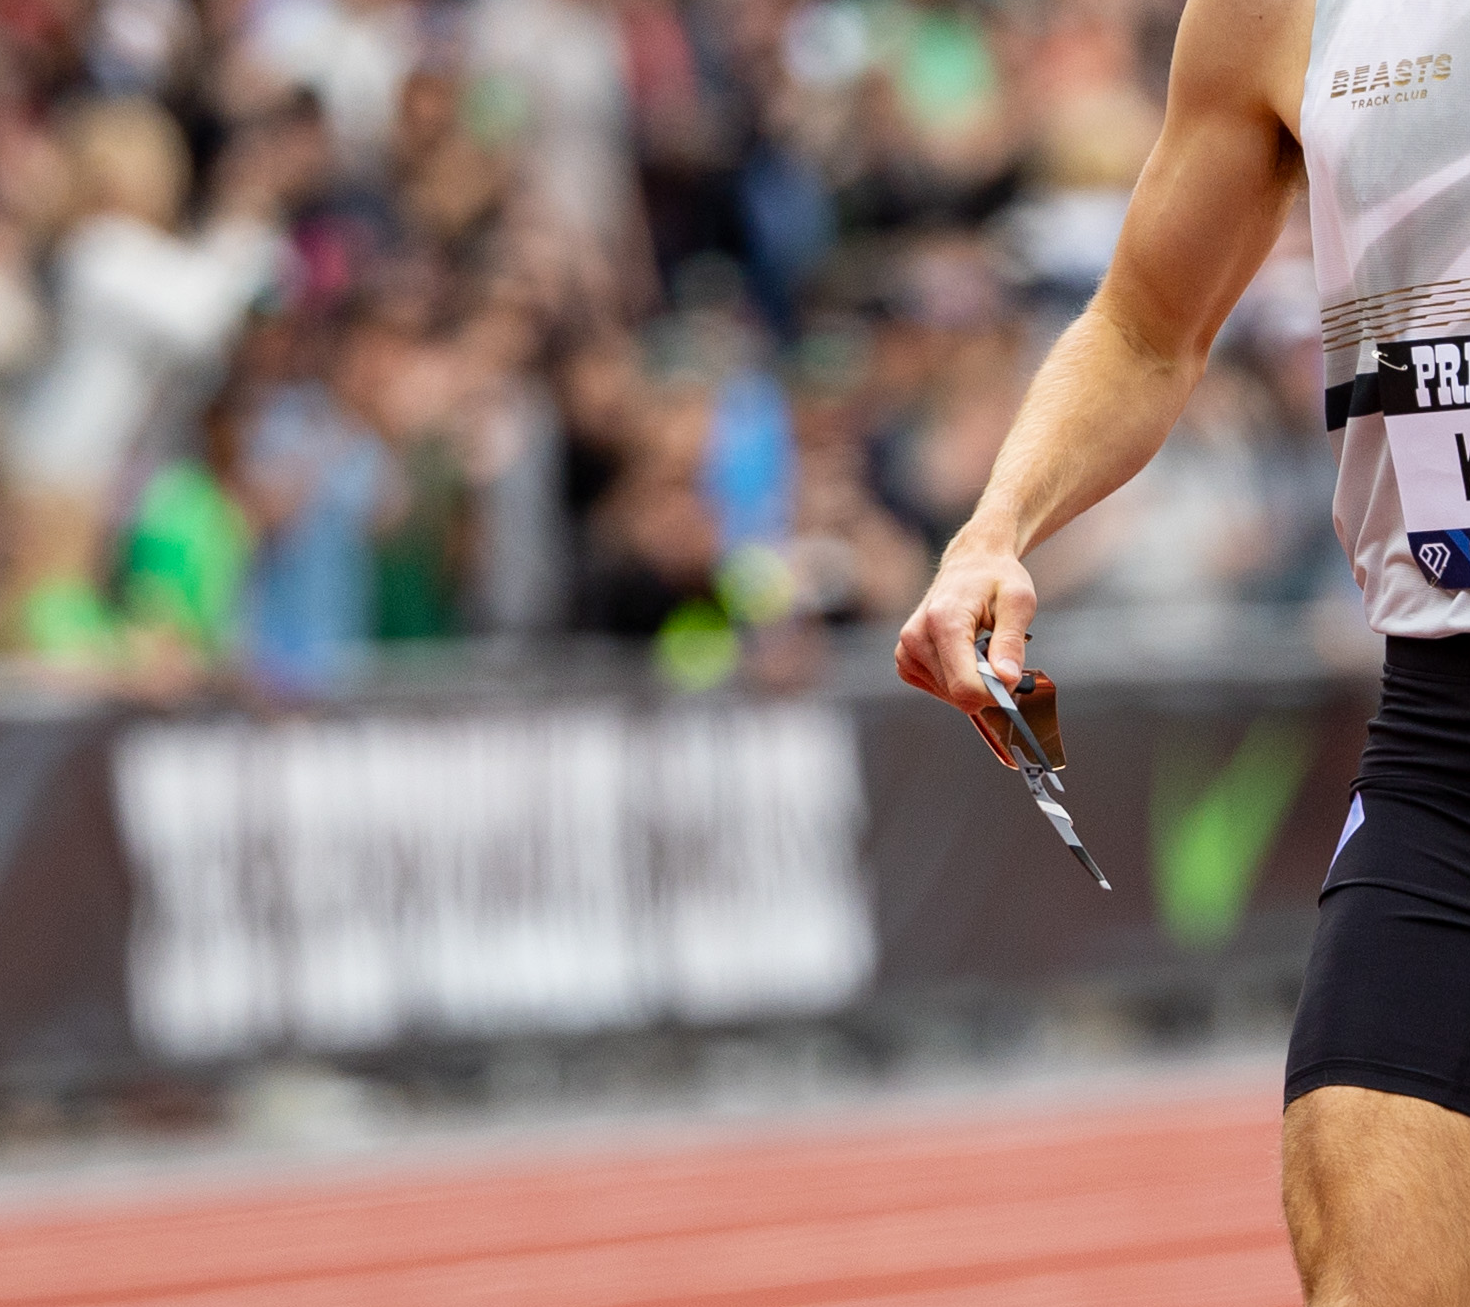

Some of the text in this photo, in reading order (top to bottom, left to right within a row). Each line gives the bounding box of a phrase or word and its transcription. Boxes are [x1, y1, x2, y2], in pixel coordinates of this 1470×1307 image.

[1330, 53, 1452, 98] BEASTS
[1351, 89, 1428, 110] TRACK CLUB
